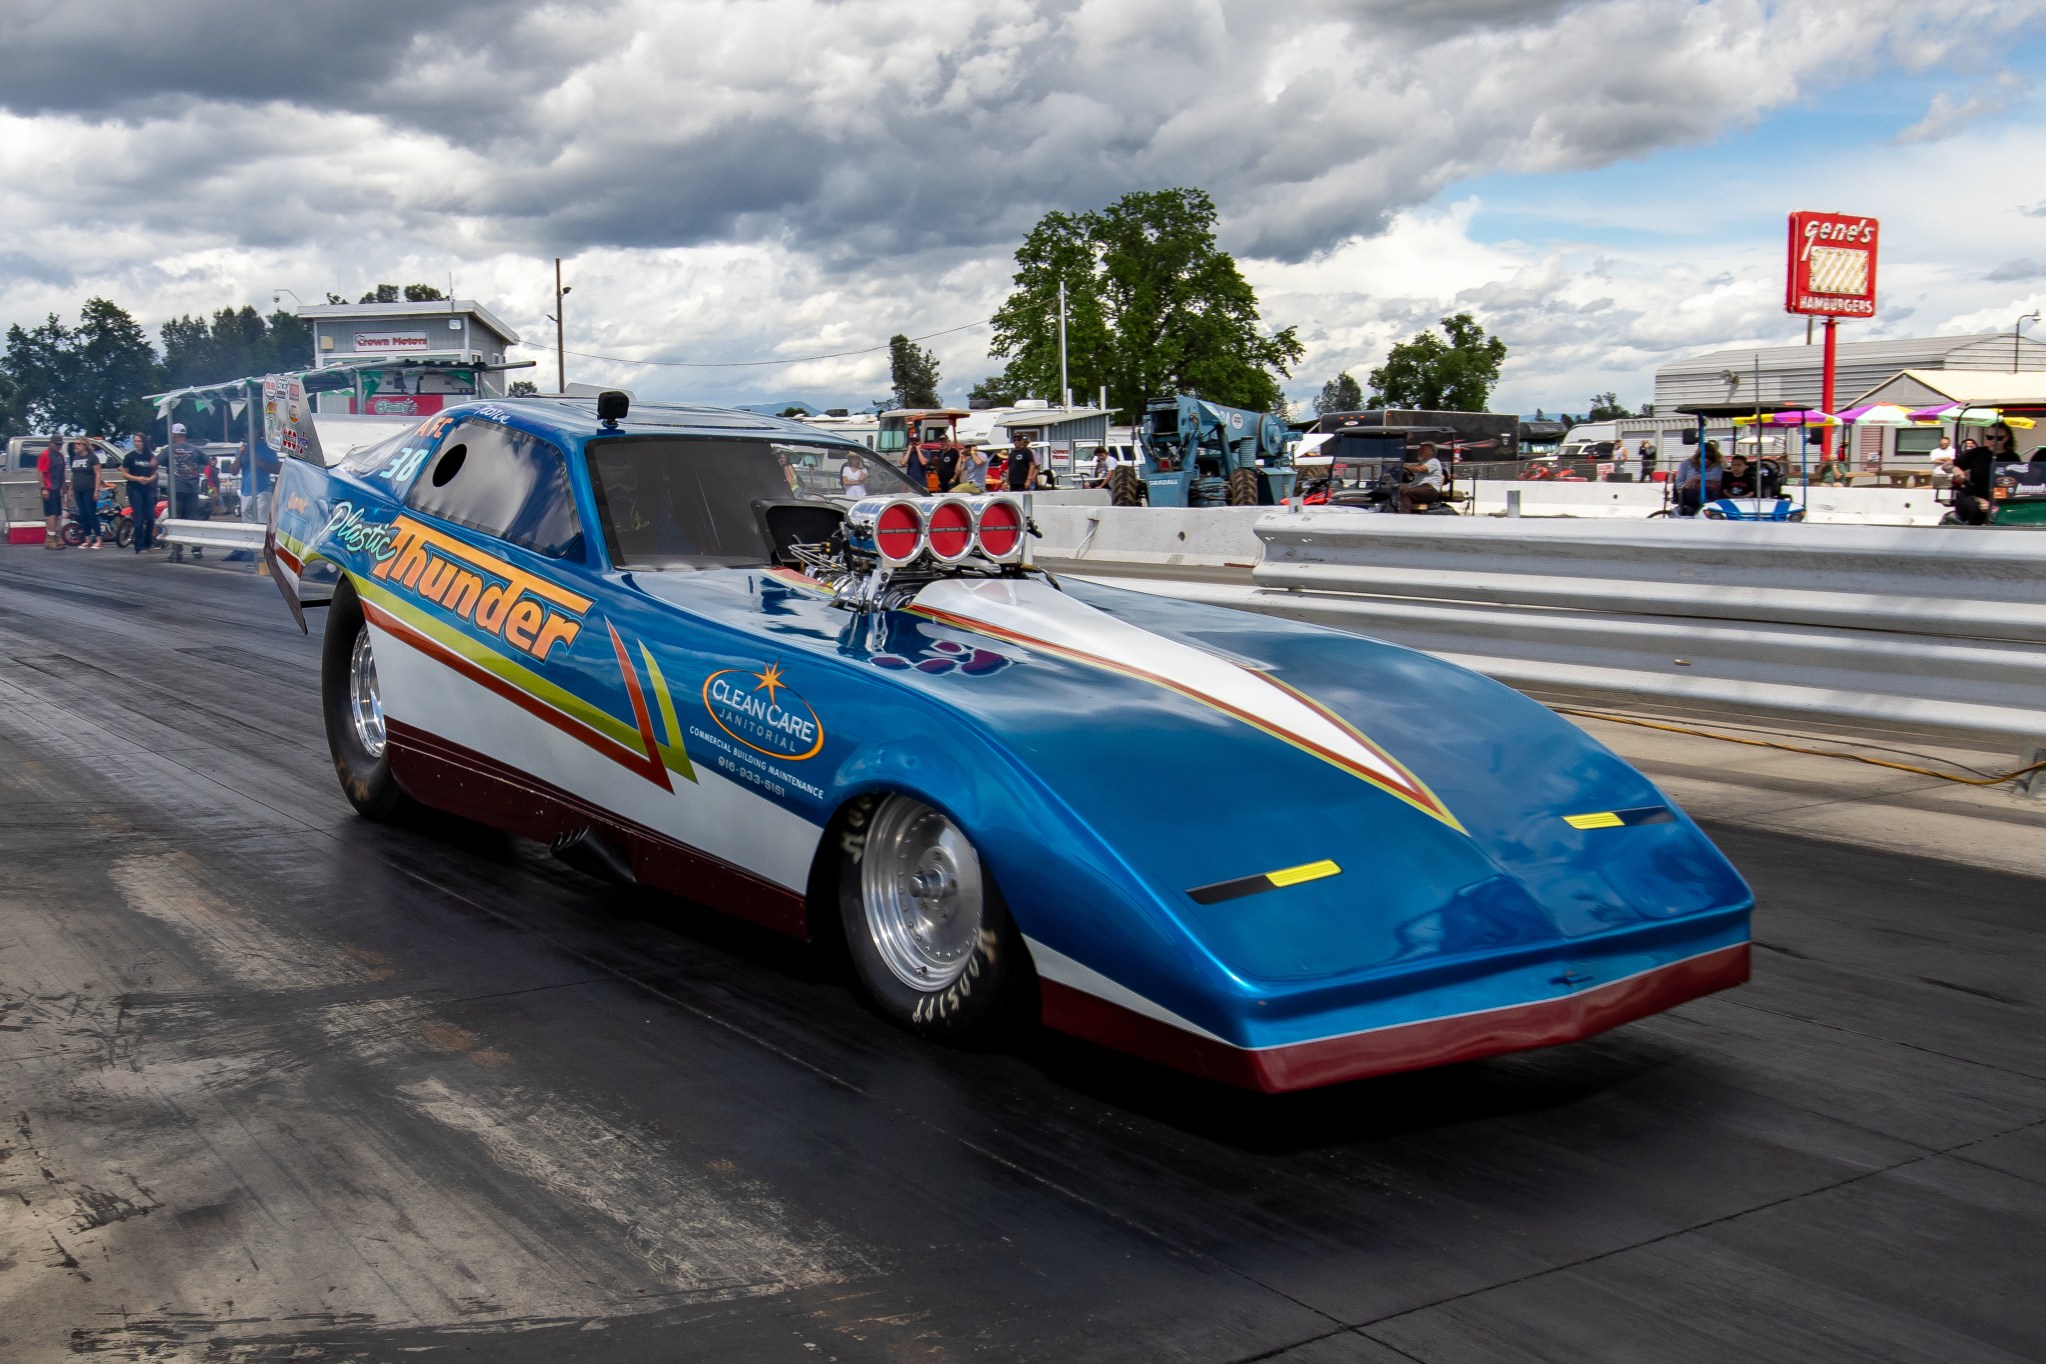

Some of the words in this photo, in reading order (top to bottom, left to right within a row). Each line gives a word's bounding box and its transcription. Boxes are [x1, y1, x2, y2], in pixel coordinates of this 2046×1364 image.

[1800, 296, 1873, 313] HAMBURGERS
[357, 337, 390, 347] Crown
[393, 337, 428, 346] Motors
[379, 447, 429, 481] 38
[311, 501, 397, 562] Plastic
[370, 513, 598, 662] Thunder
[711, 679, 766, 721] CLEAN
[766, 704, 815, 743] CARE
[719, 708, 796, 753] JANITORIAL
[689, 725, 731, 753] COMMERCIAL
[732, 747, 767, 770] BUILDING
[767, 765, 824, 799] MAINTENANCE
